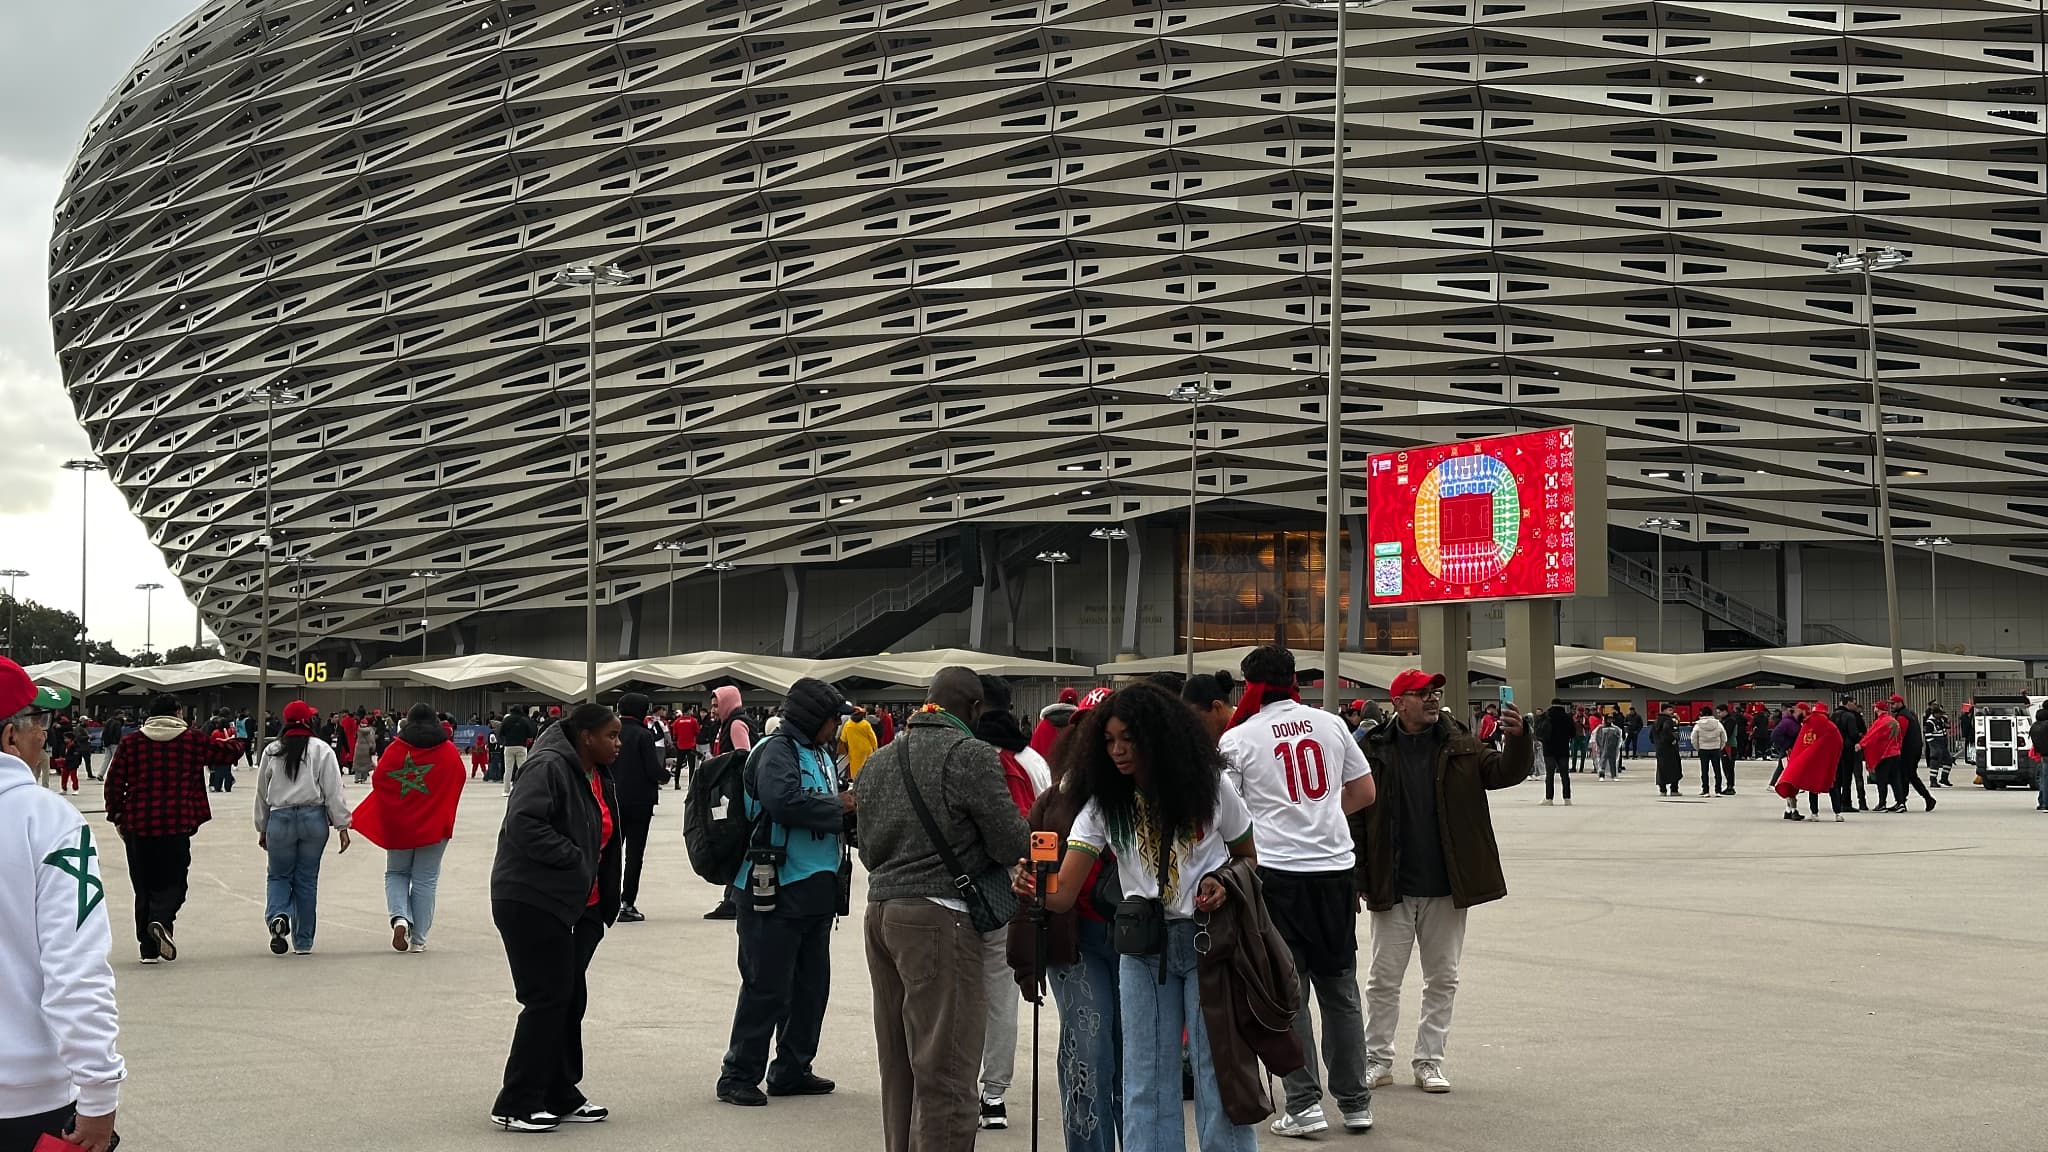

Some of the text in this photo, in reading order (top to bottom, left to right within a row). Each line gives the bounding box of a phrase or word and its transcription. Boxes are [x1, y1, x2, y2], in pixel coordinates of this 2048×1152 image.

[305, 662, 327, 683] 05
[1272, 720, 1313, 738] DOUMS
[1274, 739, 1330, 804] 10
